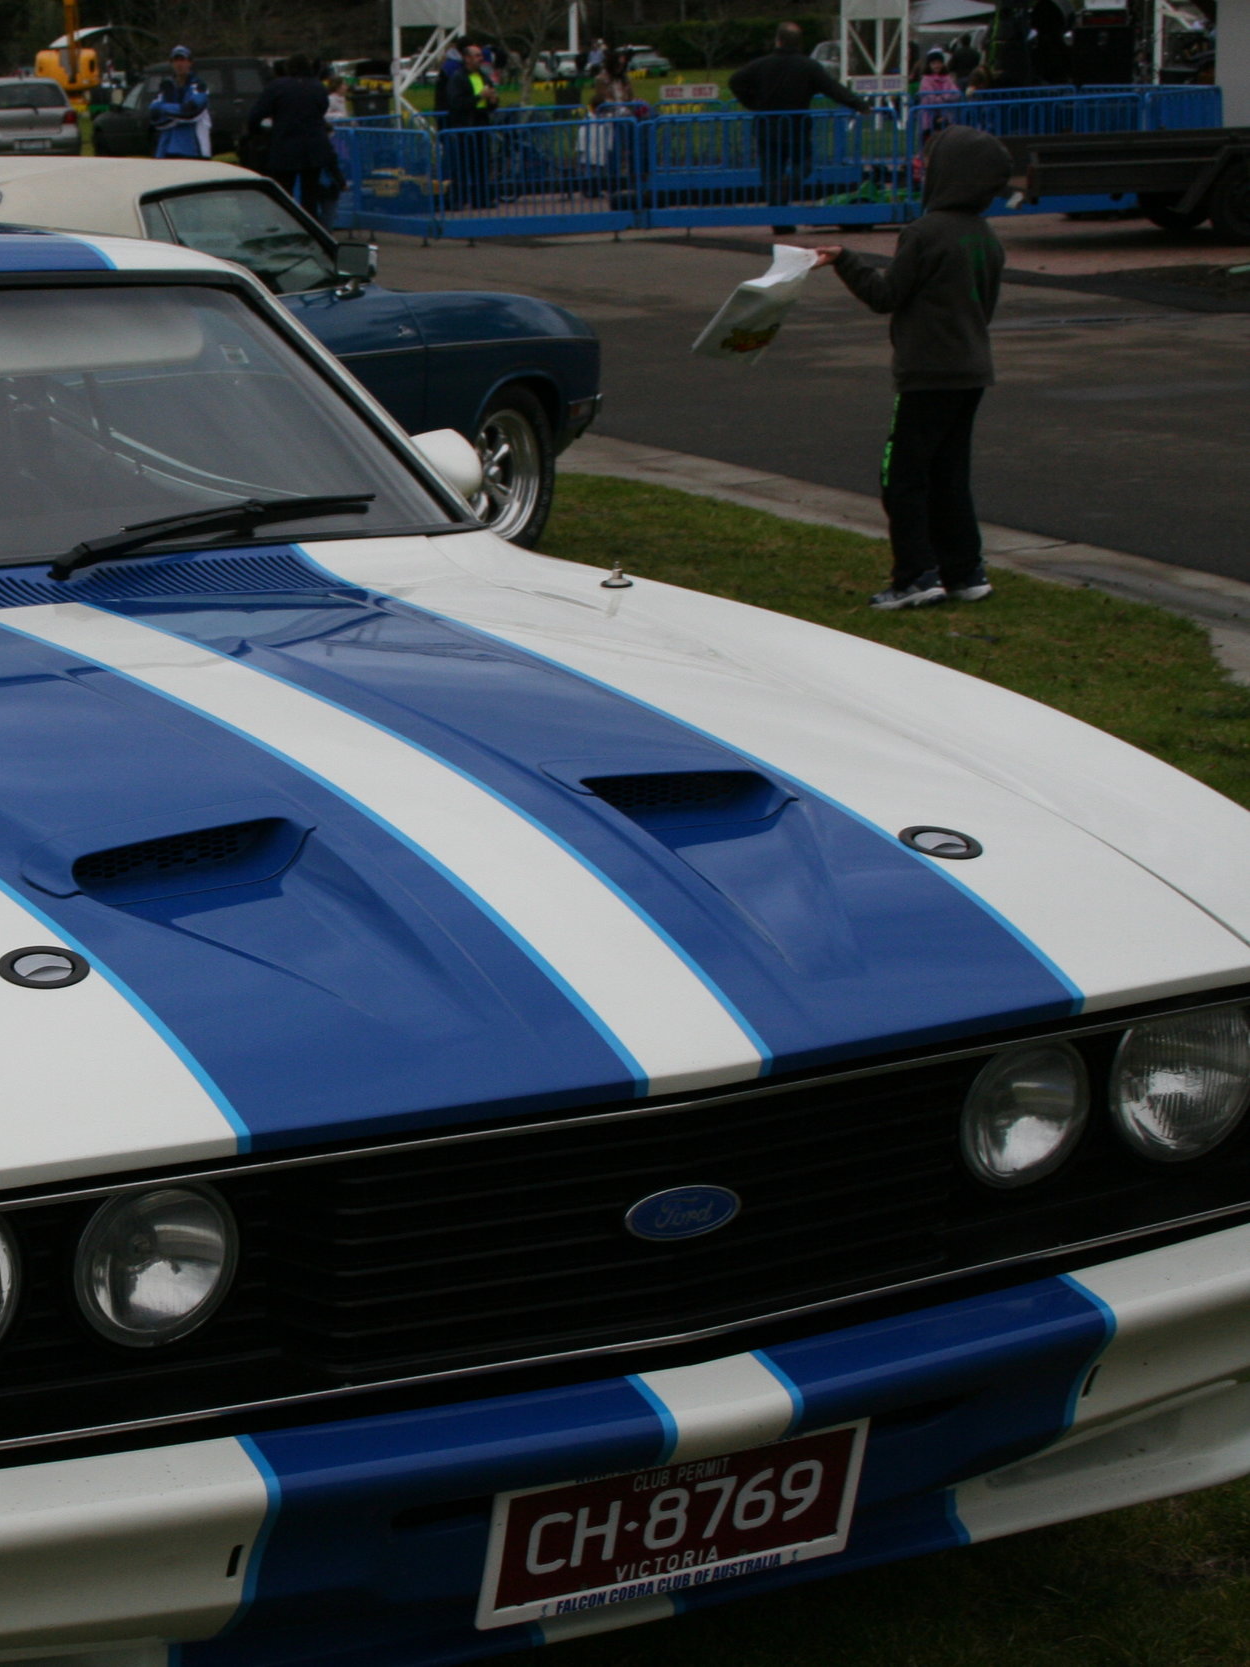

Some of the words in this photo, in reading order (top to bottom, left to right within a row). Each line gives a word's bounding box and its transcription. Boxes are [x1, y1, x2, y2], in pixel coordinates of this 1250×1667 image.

[654, 1196, 715, 1229] Ford
[633, 1469, 671, 1493] CLUB
[676, 1457, 732, 1484] PERMIT
[615, 1546, 720, 1583] VICTORIA
[556, 1588, 606, 1615] FALCON
[609, 1579, 655, 1603] COBRA
[656, 1572, 691, 1592] CLUB
[694, 1567, 713, 1585] OF
[713, 1552, 783, 1583] AUSTRALIA
